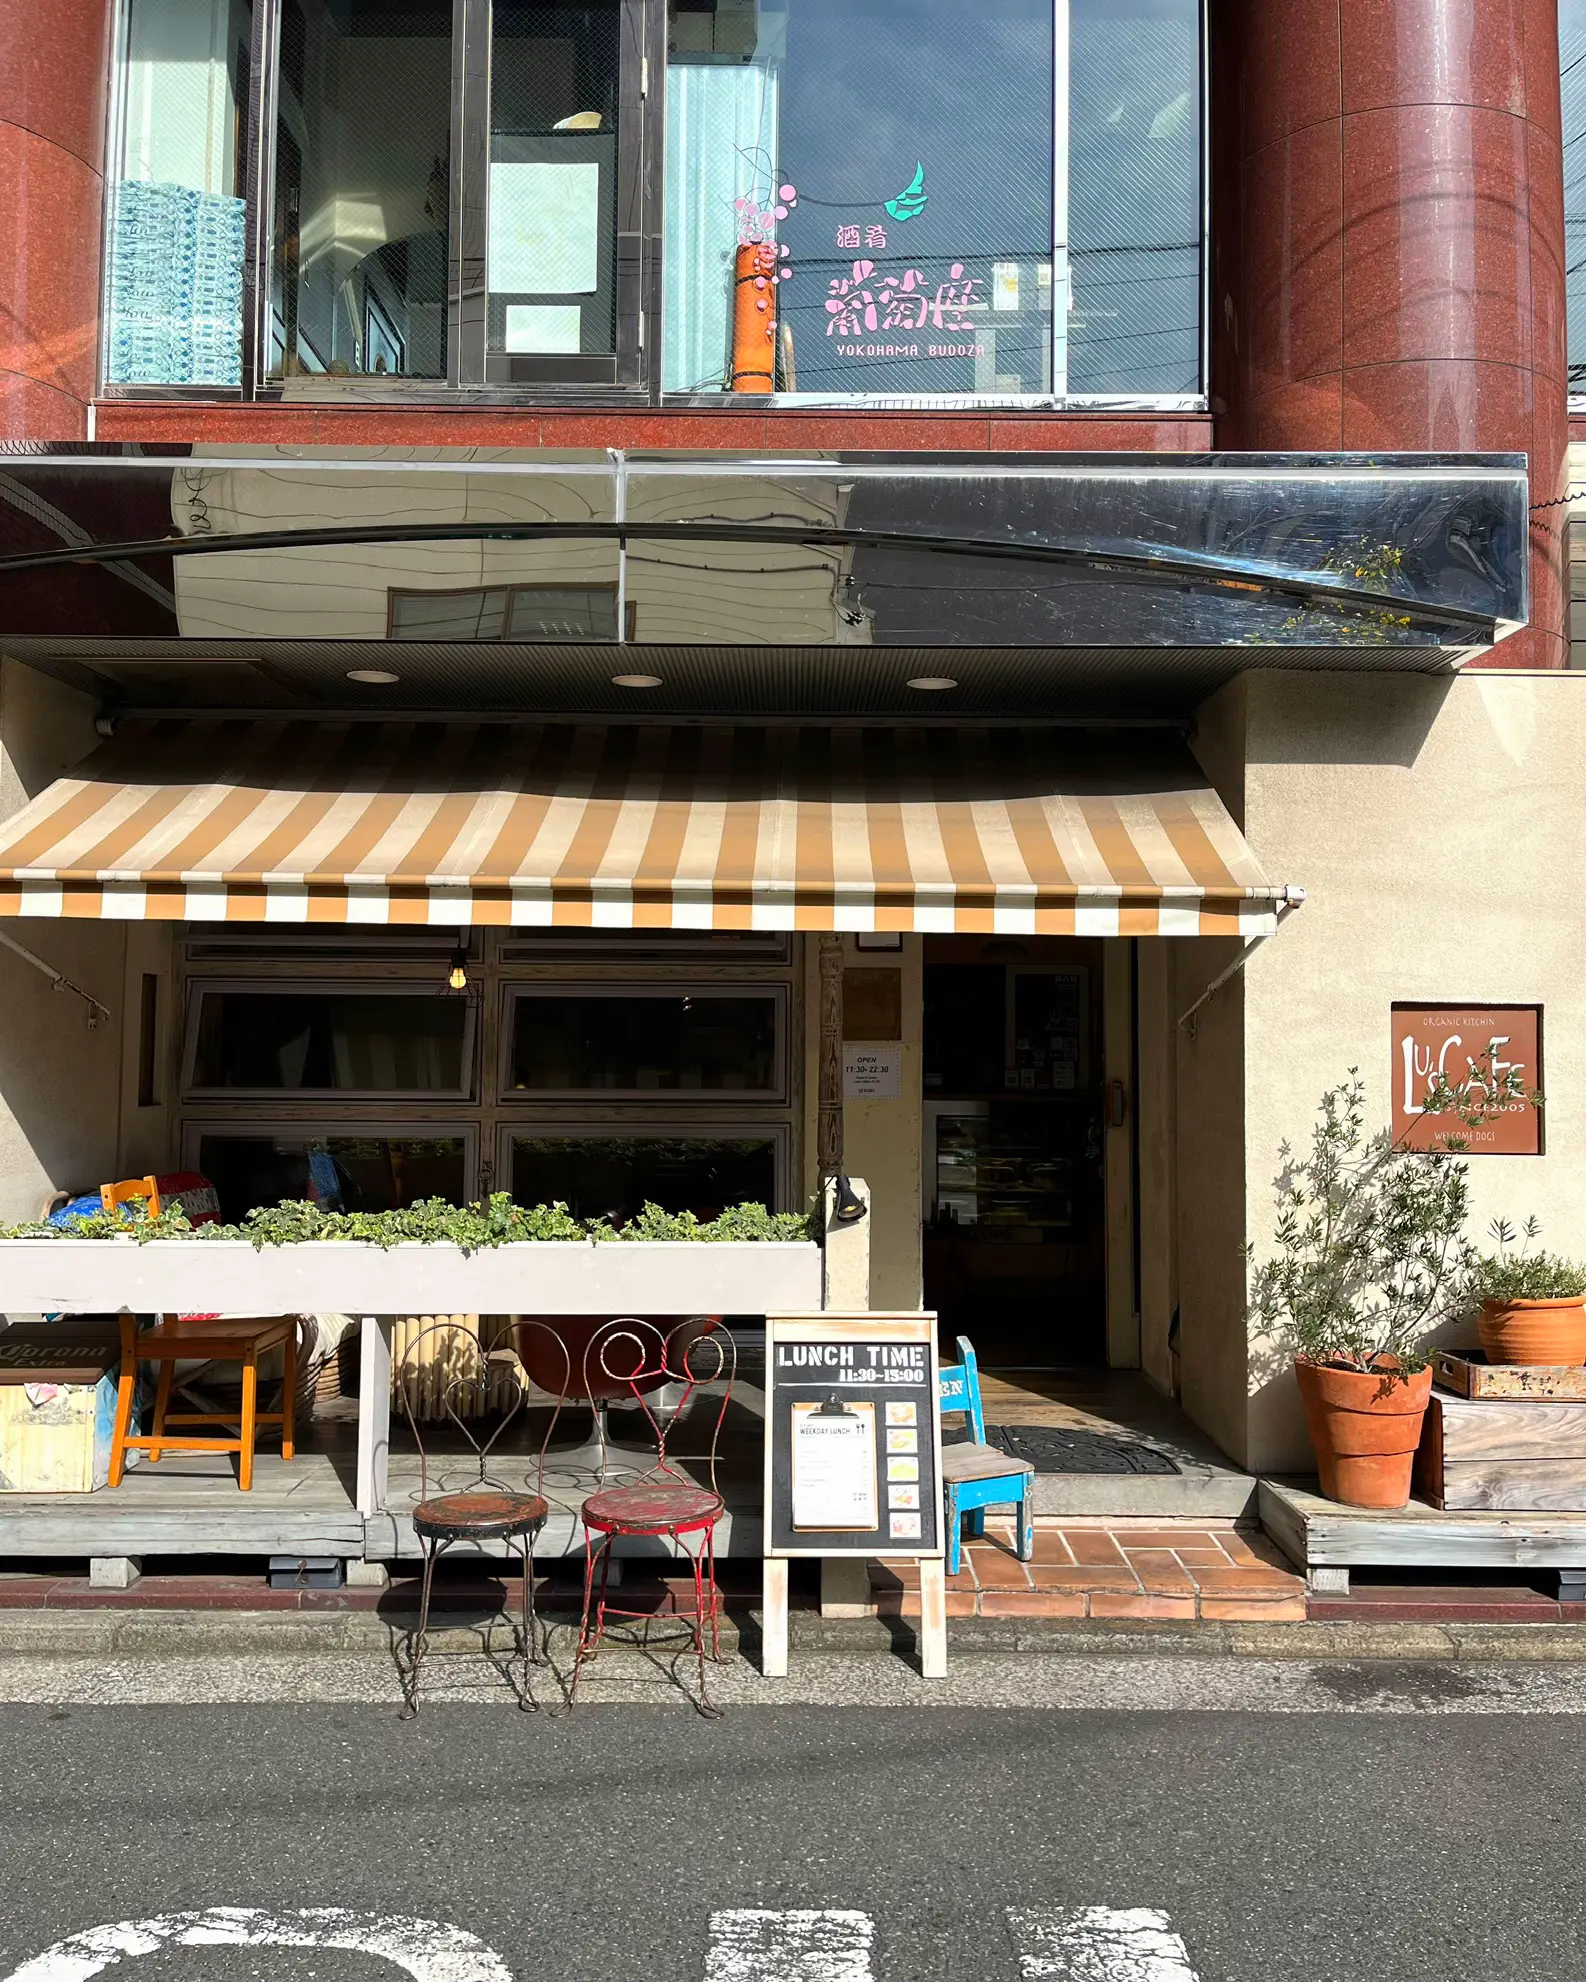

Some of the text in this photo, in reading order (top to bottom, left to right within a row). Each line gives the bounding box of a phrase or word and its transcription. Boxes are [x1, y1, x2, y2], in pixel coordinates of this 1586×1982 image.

[836, 224, 888, 249] 酒肴
[837, 344, 918, 356] YOKOHAMA
[1423, 1017, 1461, 1027] ORGANIC
[1475, 1131, 1496, 1142] DOGS
[779, 1346, 924, 1367] LUNCH TIME
[839, 1368, 924, 1383] 11:30~15:00
[799, 1427, 851, 1436] WEEKDAY LUNCH
